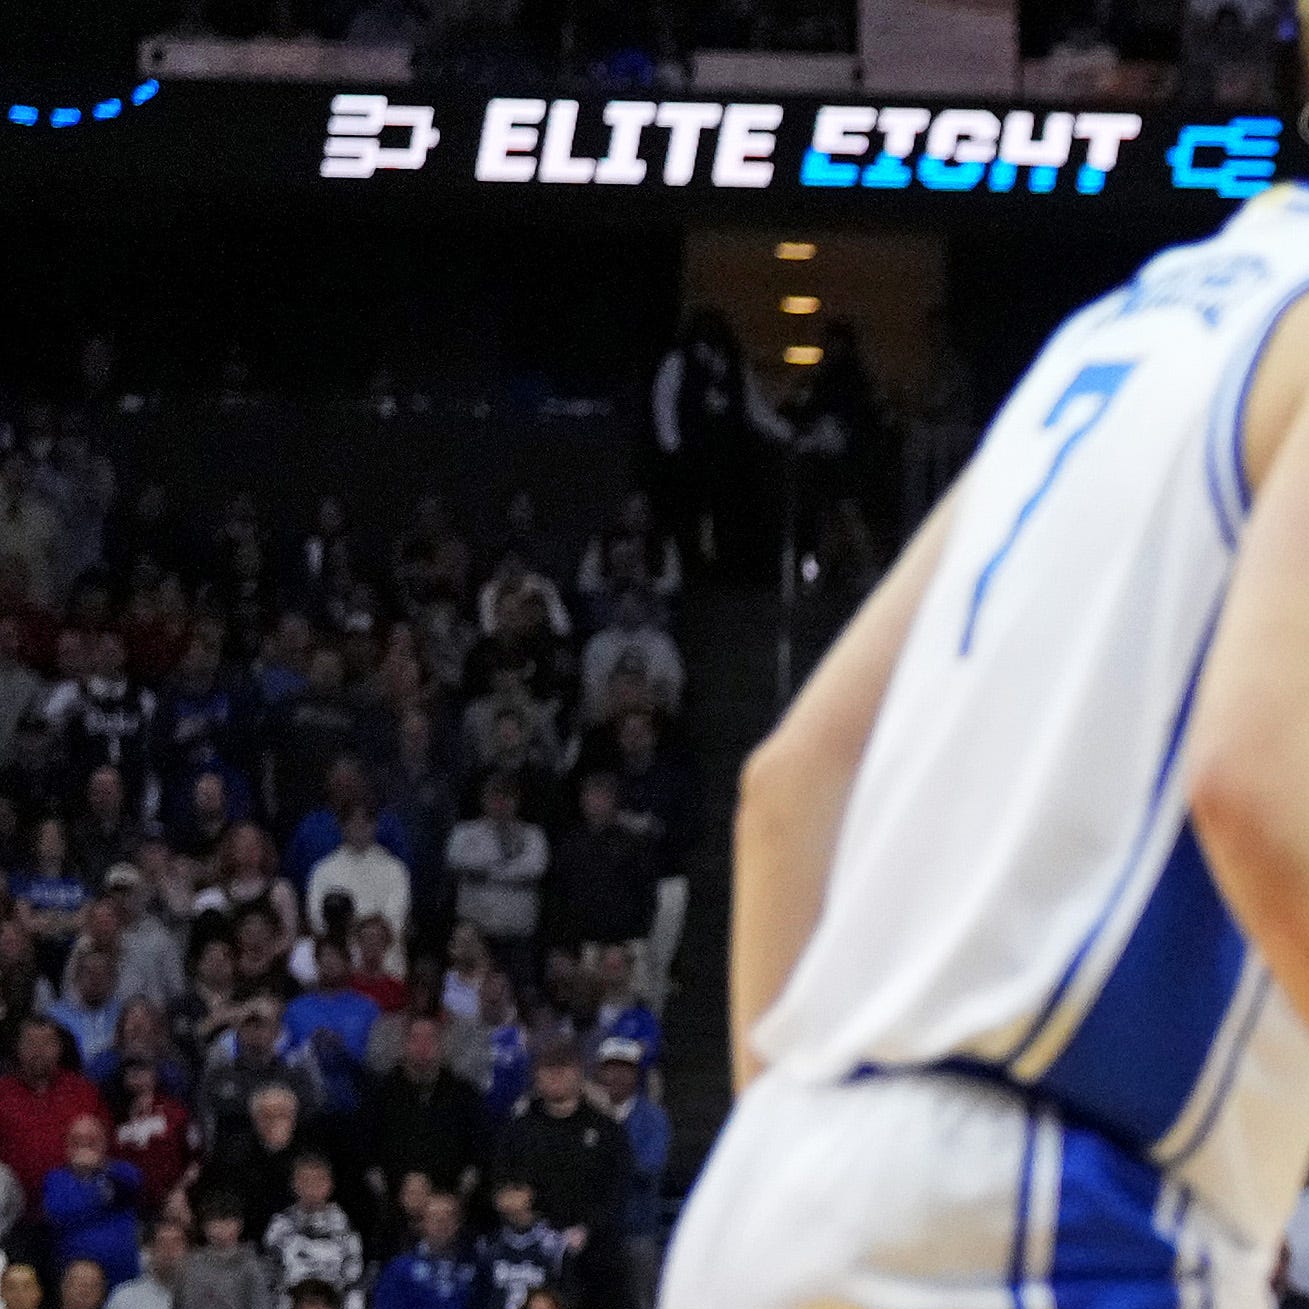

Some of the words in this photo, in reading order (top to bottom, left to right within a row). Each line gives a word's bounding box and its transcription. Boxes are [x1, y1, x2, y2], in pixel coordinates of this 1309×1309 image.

[474, 97, 785, 189] ELITE
[800, 105, 1142, 195] EIGHT
[958, 360, 1144, 657] 7
